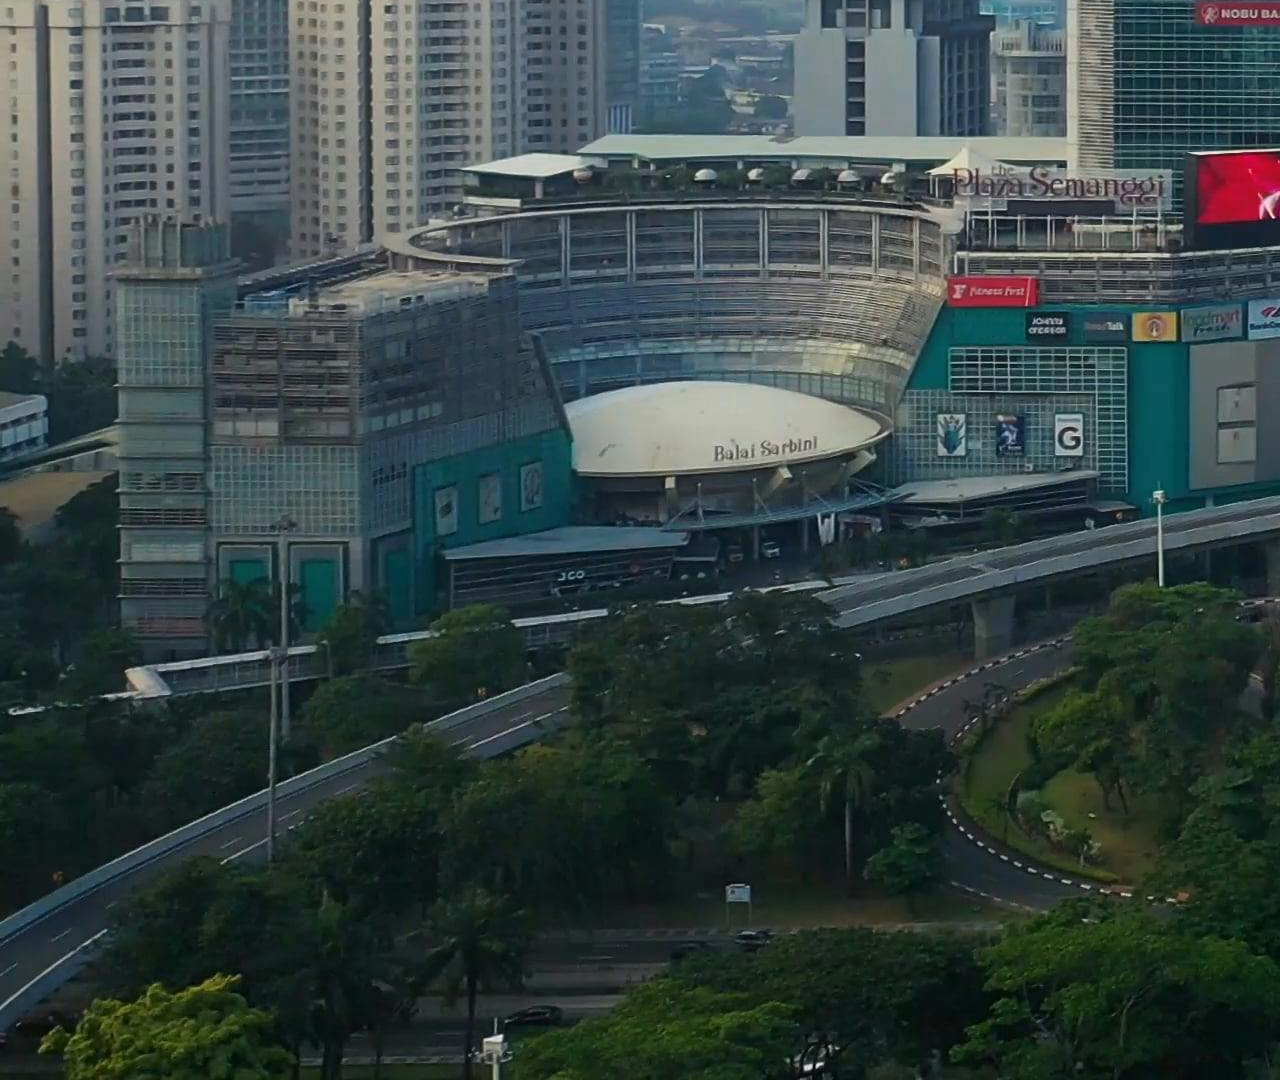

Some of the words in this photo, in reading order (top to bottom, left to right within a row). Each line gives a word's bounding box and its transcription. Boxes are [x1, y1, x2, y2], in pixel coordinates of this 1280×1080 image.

[1221, 8, 1259, 19] NOBU
[991, 164, 1016, 177] the
[952, 167, 1023, 197] Plaza
[1029, 165, 1165, 206] Semanggi
[713, 443, 756, 462] Balai
[760, 435, 818, 456] Sarbini
[1057, 426, 1081, 450] G
